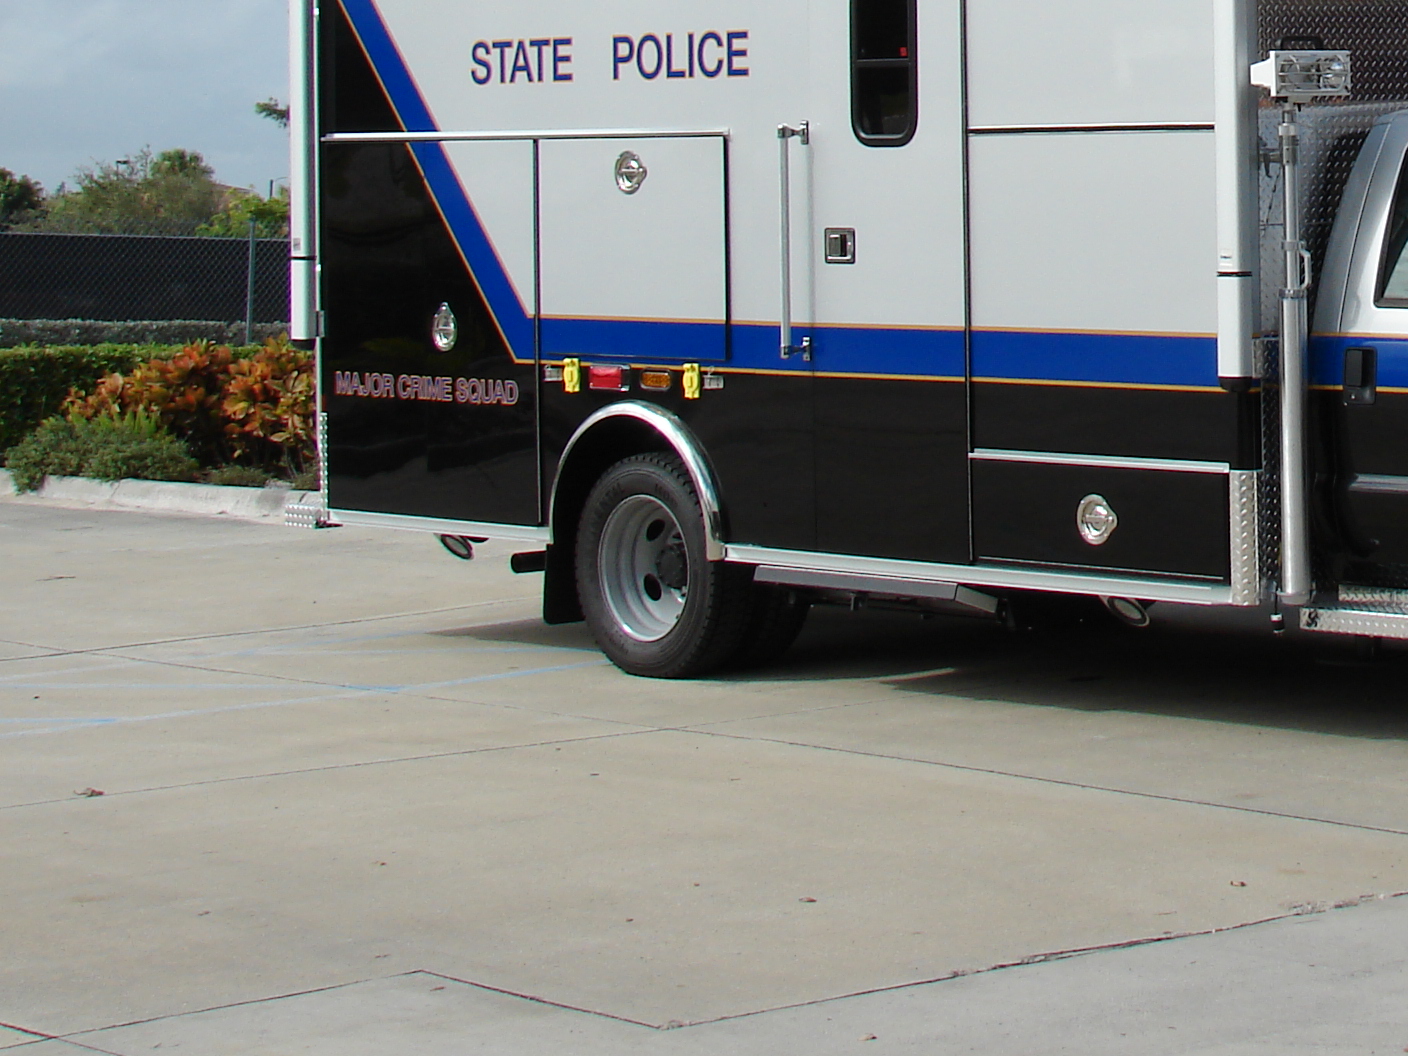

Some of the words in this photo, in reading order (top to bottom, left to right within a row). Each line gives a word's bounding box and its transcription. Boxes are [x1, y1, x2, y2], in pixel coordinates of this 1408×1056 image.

[470, 36, 574, 86] STATE
[611, 28, 750, 82] POLICE
[334, 370, 396, 398] MAJOR
[397, 373, 454, 402] CRIME
[455, 376, 519, 406] SQUAD
